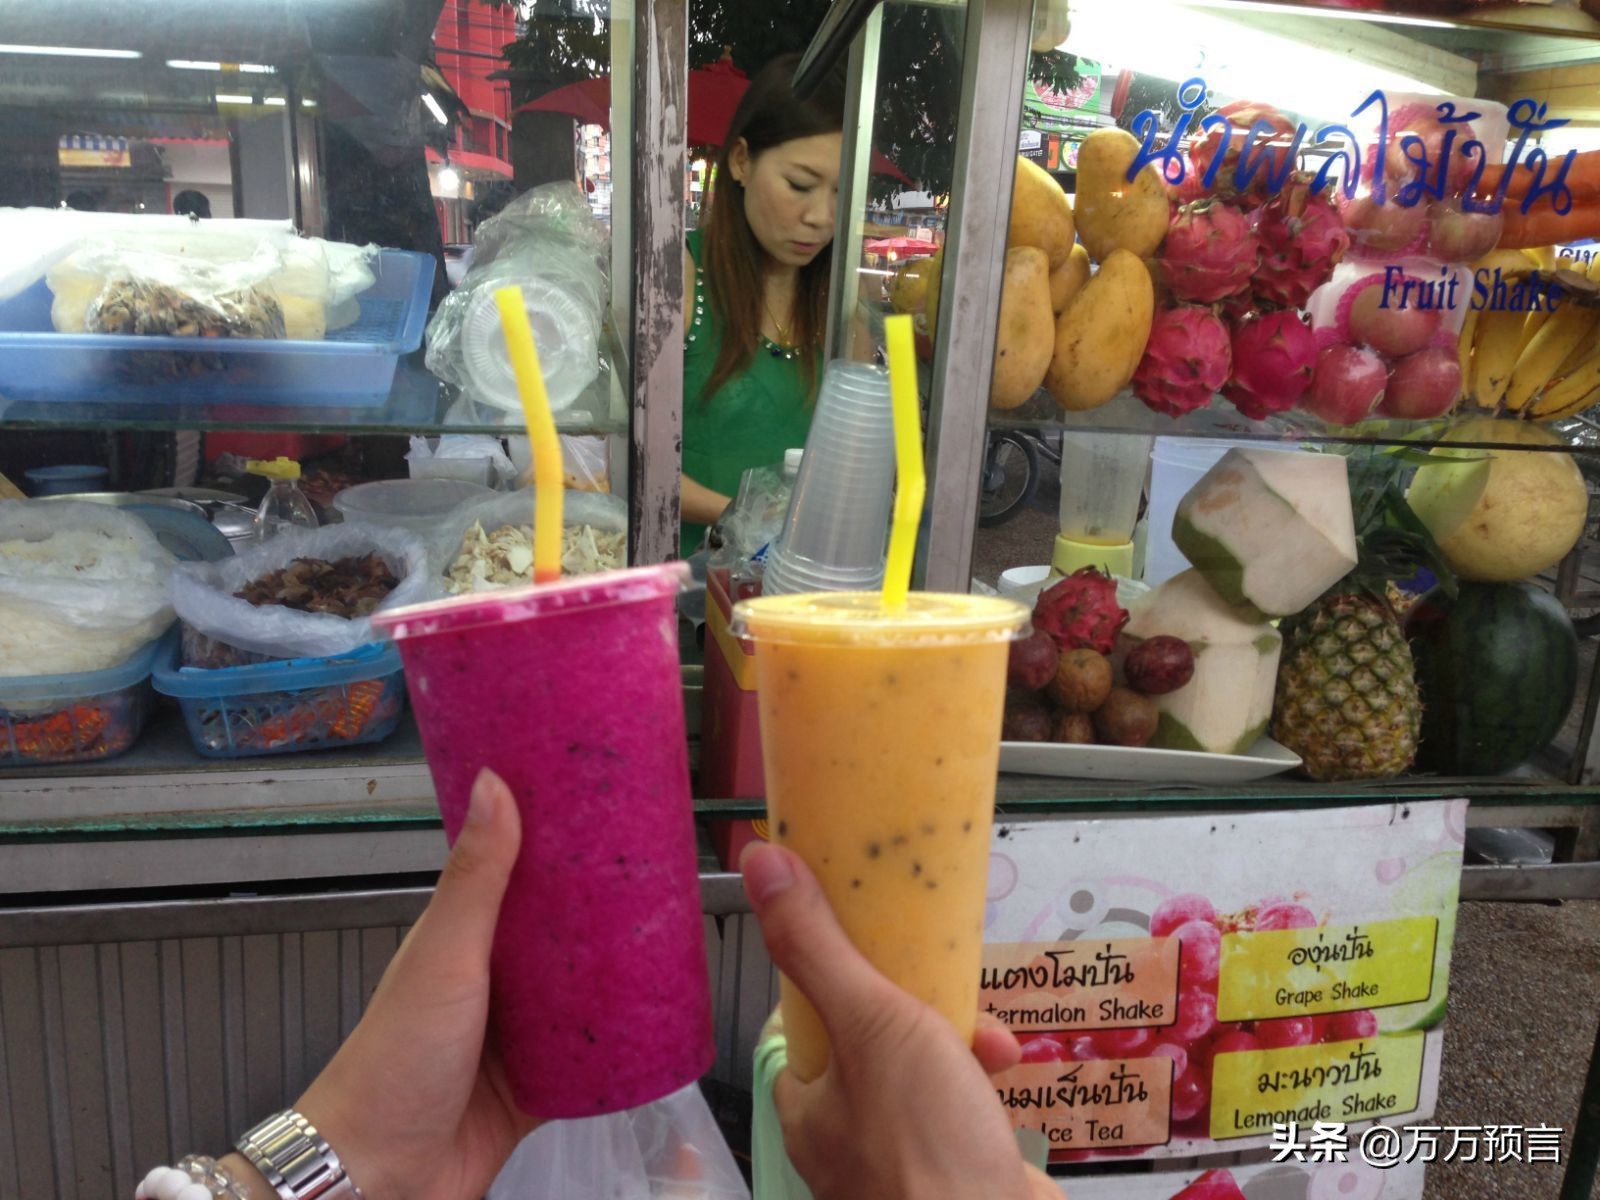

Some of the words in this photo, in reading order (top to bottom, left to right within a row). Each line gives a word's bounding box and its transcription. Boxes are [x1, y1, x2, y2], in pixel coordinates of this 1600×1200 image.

[1379, 265, 1459, 311] Fruit
[1470, 266, 1566, 312] Shake
[1287, 926, 1374, 972] องุ่นปั่น
[1099, 997, 1164, 1021] Shake
[1275, 988, 1322, 1007] Grape
[1331, 981, 1379, 1001] Shake
[1257, 1043, 1382, 1093] มะนาวปั่น
[1234, 1100, 1331, 1129] Lemonade
[1342, 1093, 1397, 1116] Shake
[1085, 1120, 1123, 1141] Tea
